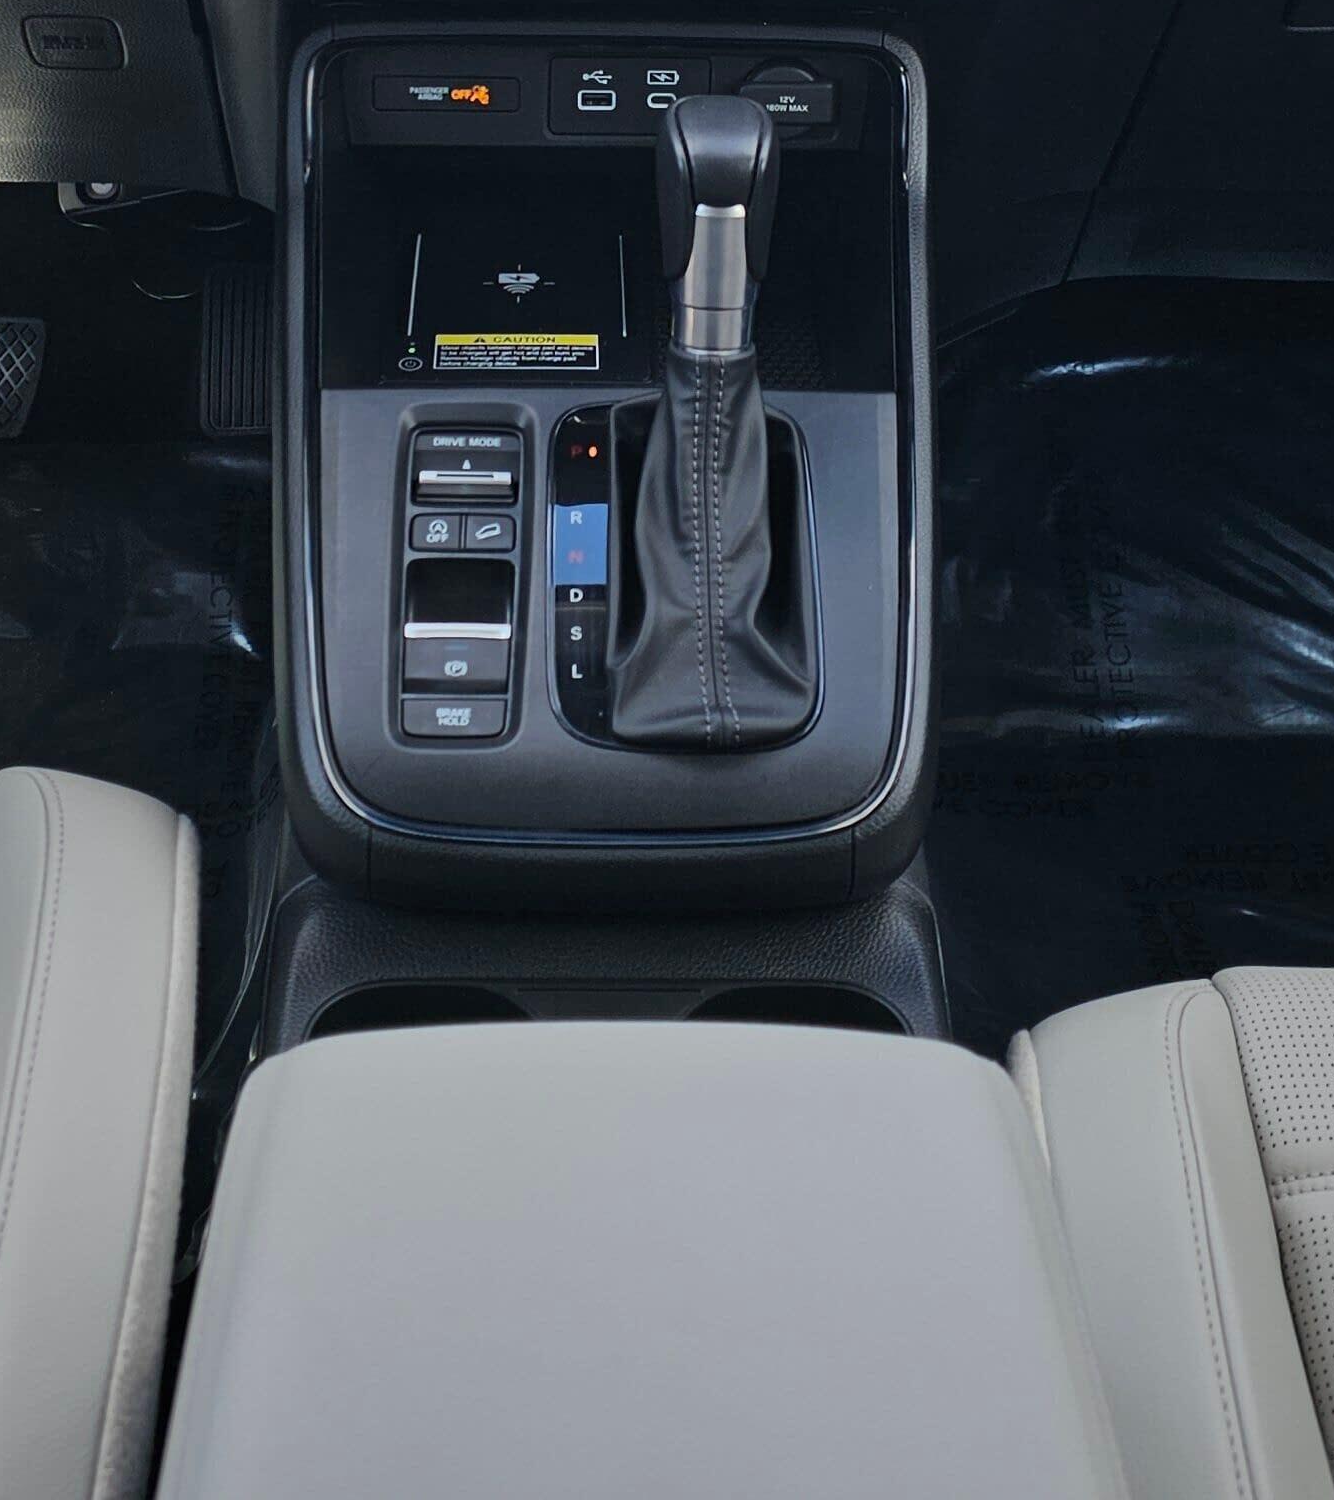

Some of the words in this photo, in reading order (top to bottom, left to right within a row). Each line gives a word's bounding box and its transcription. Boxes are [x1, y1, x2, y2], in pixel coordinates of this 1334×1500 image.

[451, 88, 472, 101] OFF
[779, 96, 796, 104] 12V
[789, 104, 809, 113] MAX
[493, 336, 556, 344] CAUTION
[433, 436, 466, 447] DRIVE
[469, 436, 501, 447] MODE
[570, 511, 583, 525] R
[426, 533, 449, 543] OFF
[569, 588, 584, 603] D
[570, 625, 583, 641] S
[571, 663, 583, 679] L
[435, 707, 471, 717] BRAKE
[438, 717, 470, 726] HOLD
